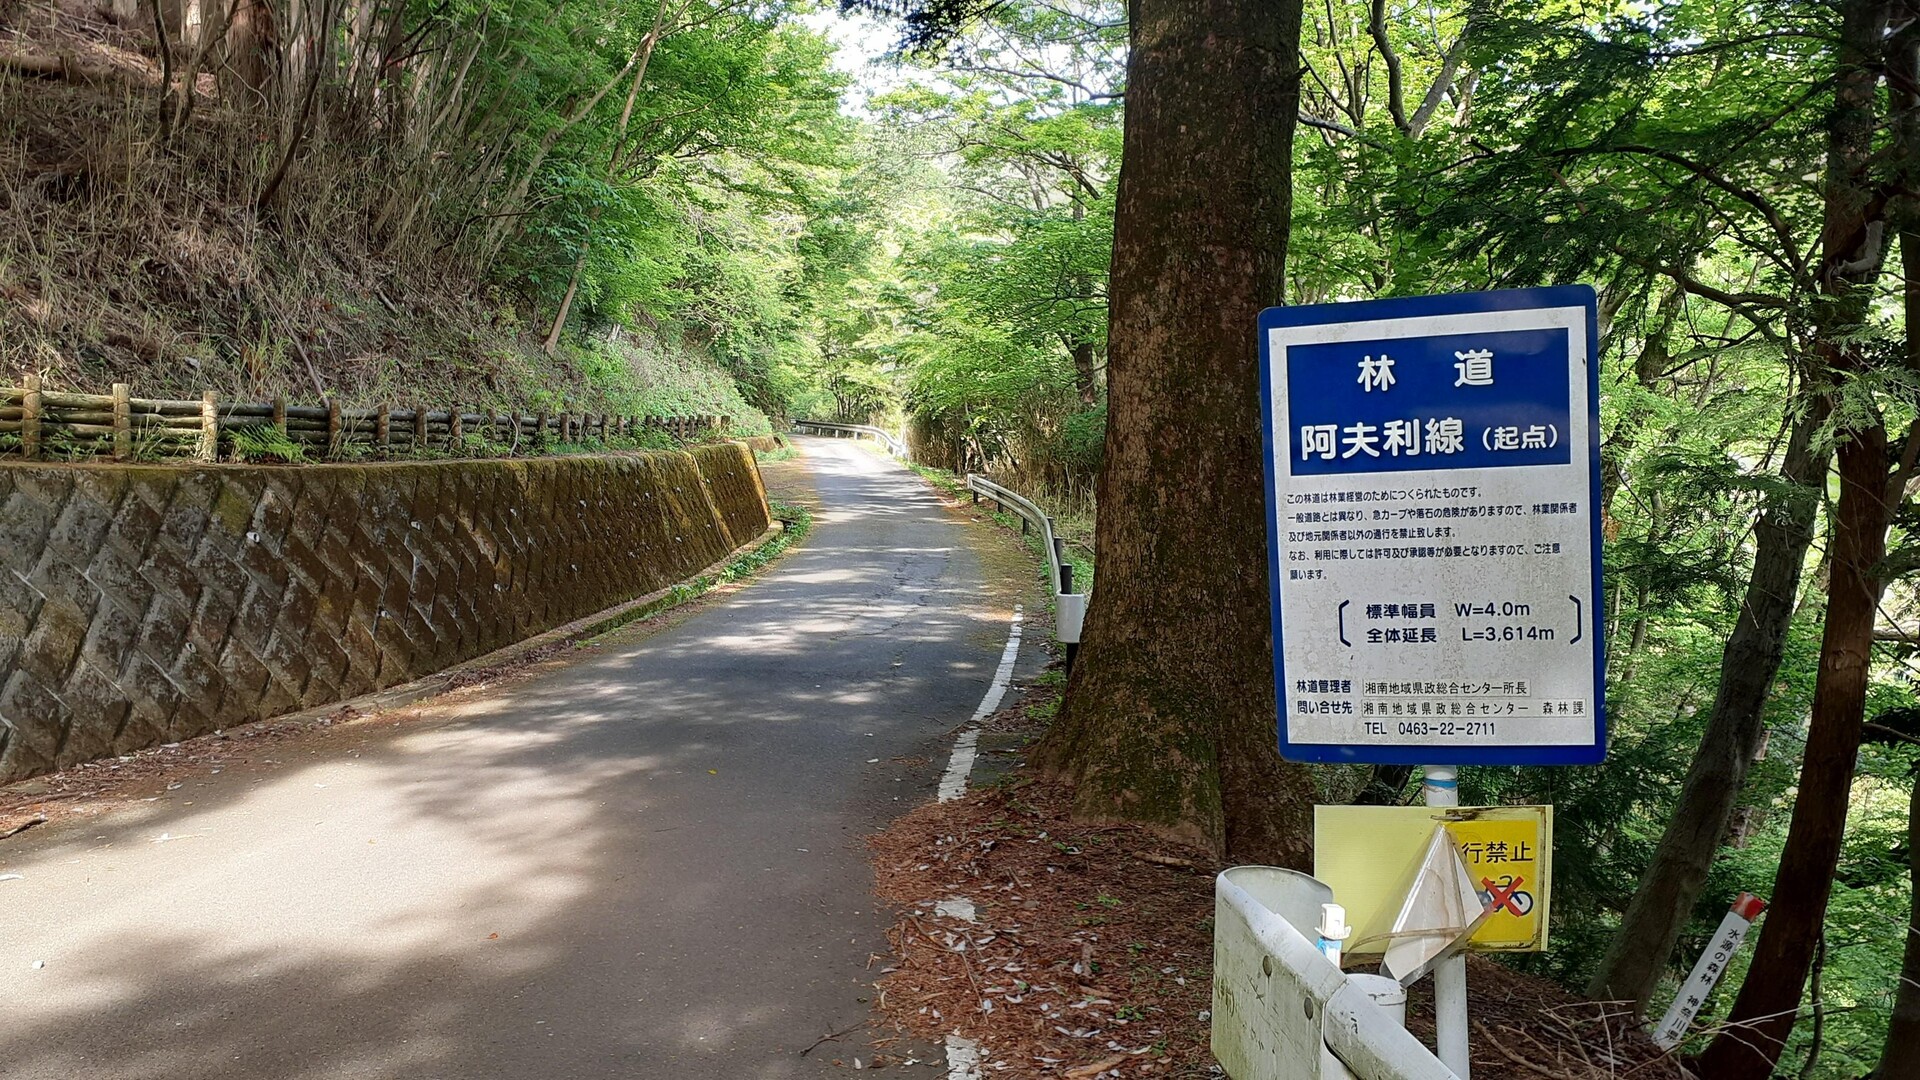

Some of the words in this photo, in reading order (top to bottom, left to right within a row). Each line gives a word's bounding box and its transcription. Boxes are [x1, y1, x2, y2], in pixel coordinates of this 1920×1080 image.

[1286, 487, 1482, 505] この林道は林業経営のためにつくられたものです。
[1288, 527, 1456, 542] 及び地元関係者以外の通行を禁止致します。
[1290, 569, 1327, 581] 願います。
[1365, 602, 1436, 619] 標準幅員
[1455, 601, 1531, 617] W=4.0m
[1366, 627, 1437, 643] 全体延長
[1296, 680, 1352, 694] 林道管理者
[1364, 681, 1528, 695] 湘南地域県政総合センター所長
[1297, 700, 1353, 715] 問い合せ先
[1363, 703, 1529, 716] 湘南地域県政総合センター
[1542, 701, 1584, 714] 森林課
[1364, 722, 1388, 735] TEL
[1398, 722, 1495, 735] 0463-22-2711
[1700, 928, 1741, 986] 水源の森林
[1667, 995, 1700, 1041] 神奈川県
